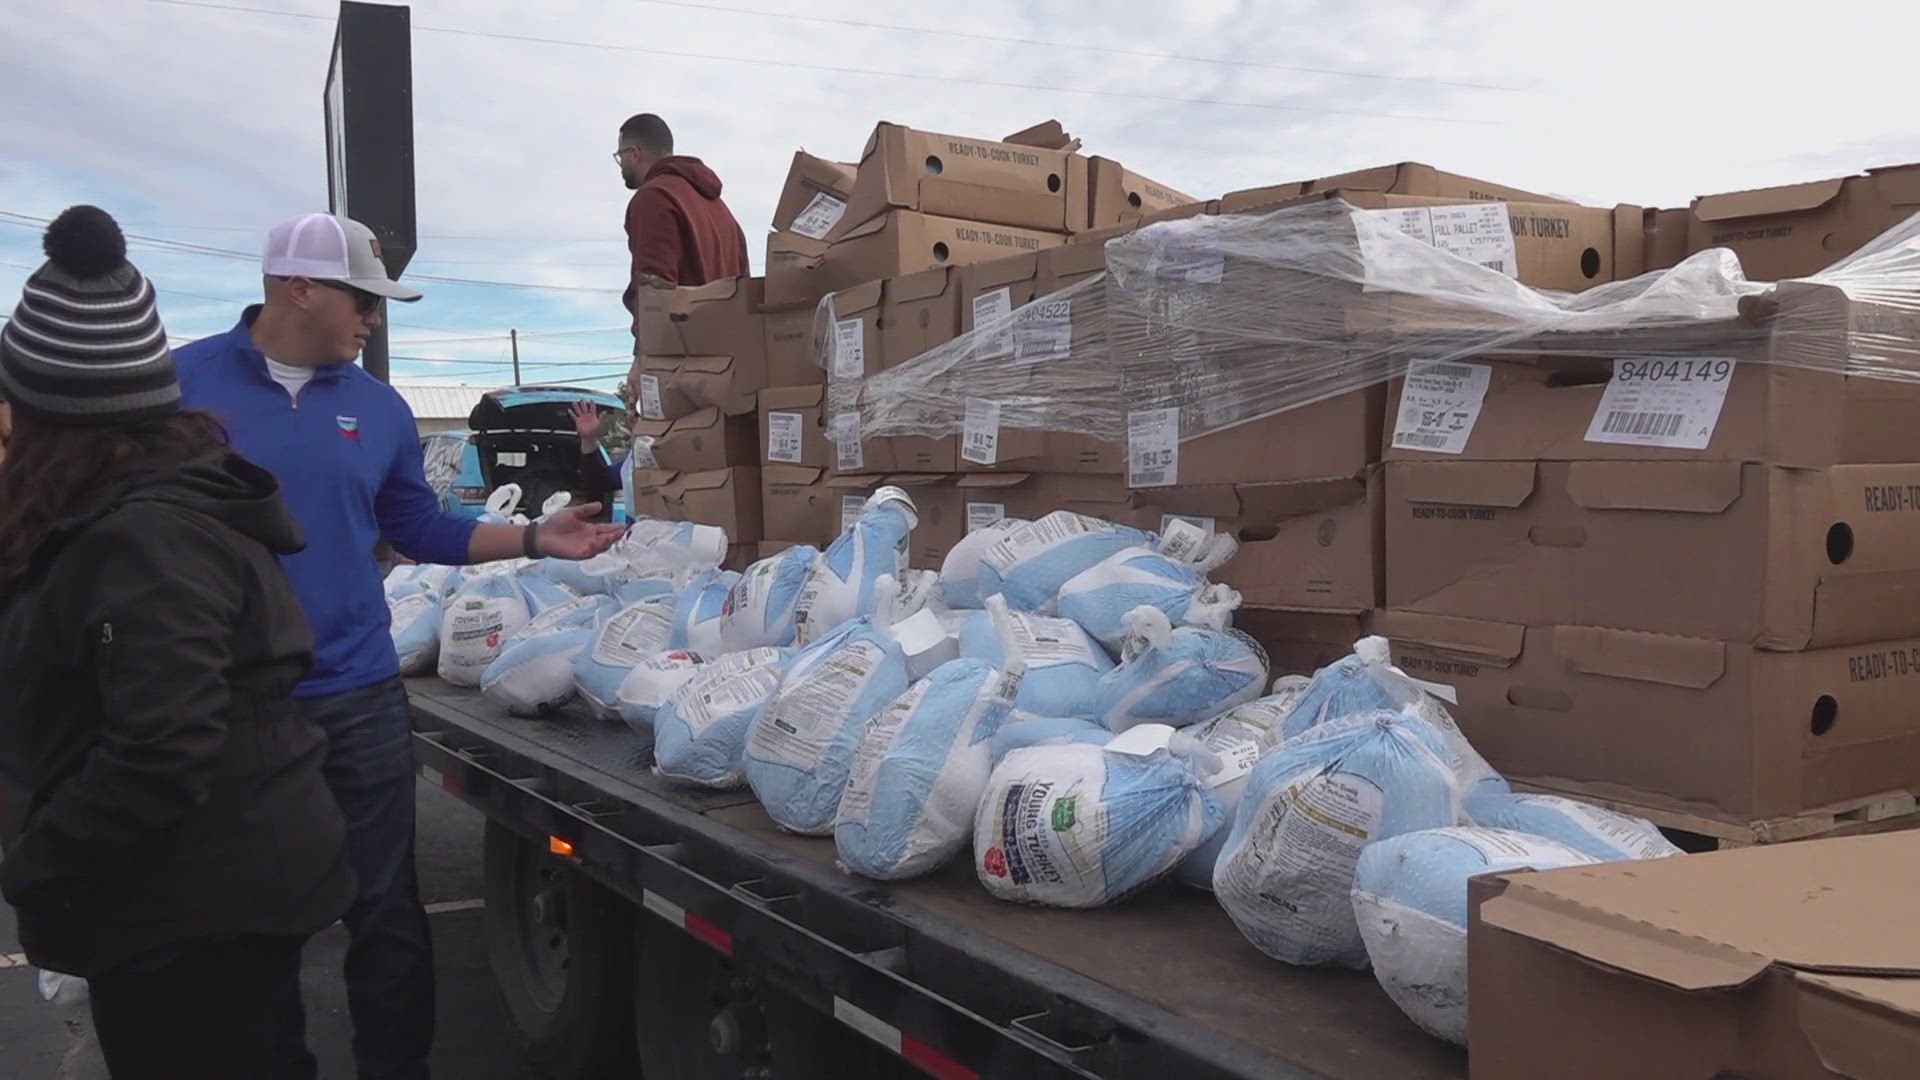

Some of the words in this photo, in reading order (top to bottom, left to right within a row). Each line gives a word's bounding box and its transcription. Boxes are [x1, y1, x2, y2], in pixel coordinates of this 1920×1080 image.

[948, 142, 1011, 162] READY-TO-COOK
[1012, 151, 1040, 167] TURKEY
[956, 228, 1013, 247] READY-TO-COOK
[1014, 235, 1040, 251] TURKEY
[1453, 222, 1478, 235] PALLET
[1529, 217, 1570, 239] TURKEY
[1618, 360, 1731, 382] 8404149
[1025, 781, 1055, 830] YOUNG
[1027, 833, 1064, 885] TURKEY
